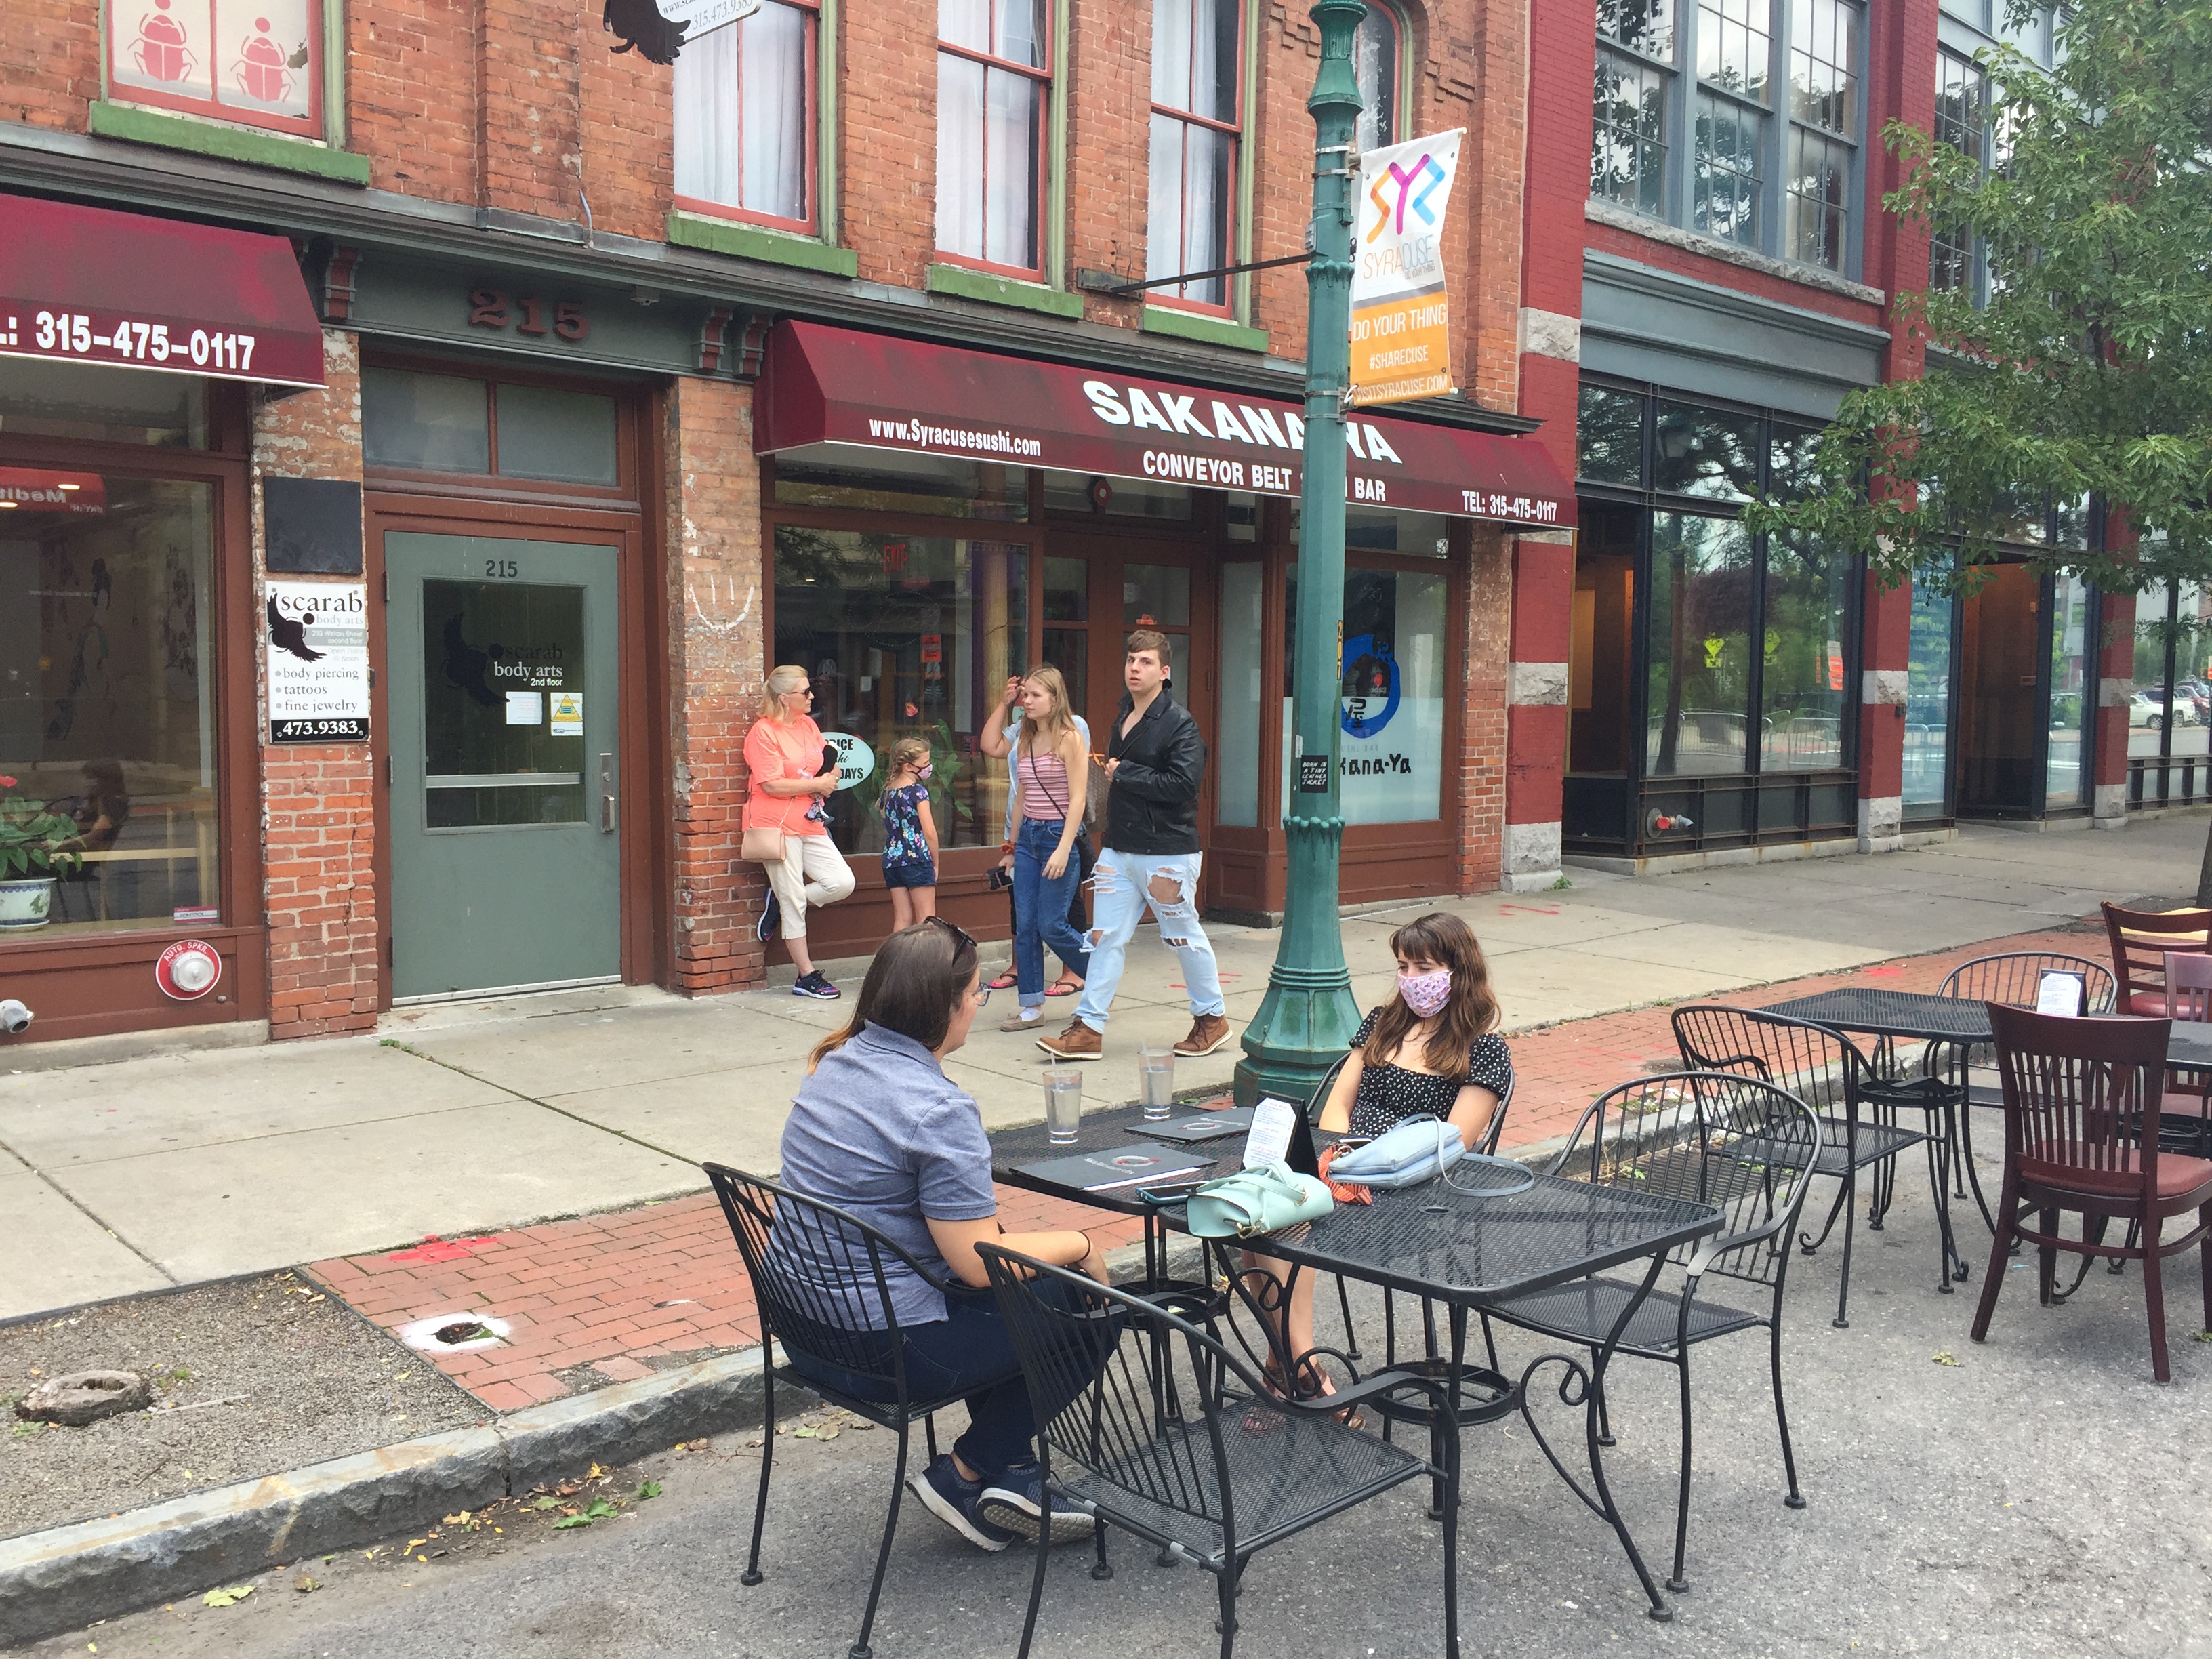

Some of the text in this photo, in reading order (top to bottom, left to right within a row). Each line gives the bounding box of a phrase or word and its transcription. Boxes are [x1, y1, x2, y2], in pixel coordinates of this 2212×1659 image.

[1363, 234, 1434, 279] SYRACUSE
[1422, 262, 1435, 275] THING
[468, 289, 590, 340] 215
[1353, 303, 1446, 342] DO YOUR THING
[35, 310, 255, 371] 315-475-0117
[1369, 345, 1429, 370] #SHARECUSE
[1356, 374, 1448, 402] VISITSYRACUSE.COM
[869, 418, 1041, 457] www.Syracusesushi.com
[1143, 450, 1244, 486] CONVEYOR
[1252, 464, 1292, 491] BELT
[1354, 476, 1387, 502] BAR
[1462, 490, 1557, 522] TEL: 315-475-0117
[485, 559, 518, 578] 215
[281, 592, 363, 613] scarab
[316, 614, 342, 626] body
[506, 643, 563, 661] scarab
[283, 667, 359, 681] body piercing
[493, 661, 564, 682] body arts
[284, 685, 328, 695] tattoos
[530, 678, 563, 687] 2nd floor
[285, 699, 359, 713] fine jewelry
[282, 720, 359, 735] 473.9383
[163, 944, 186, 962] AUTO.
[187, 941, 207, 954] SPKR.
